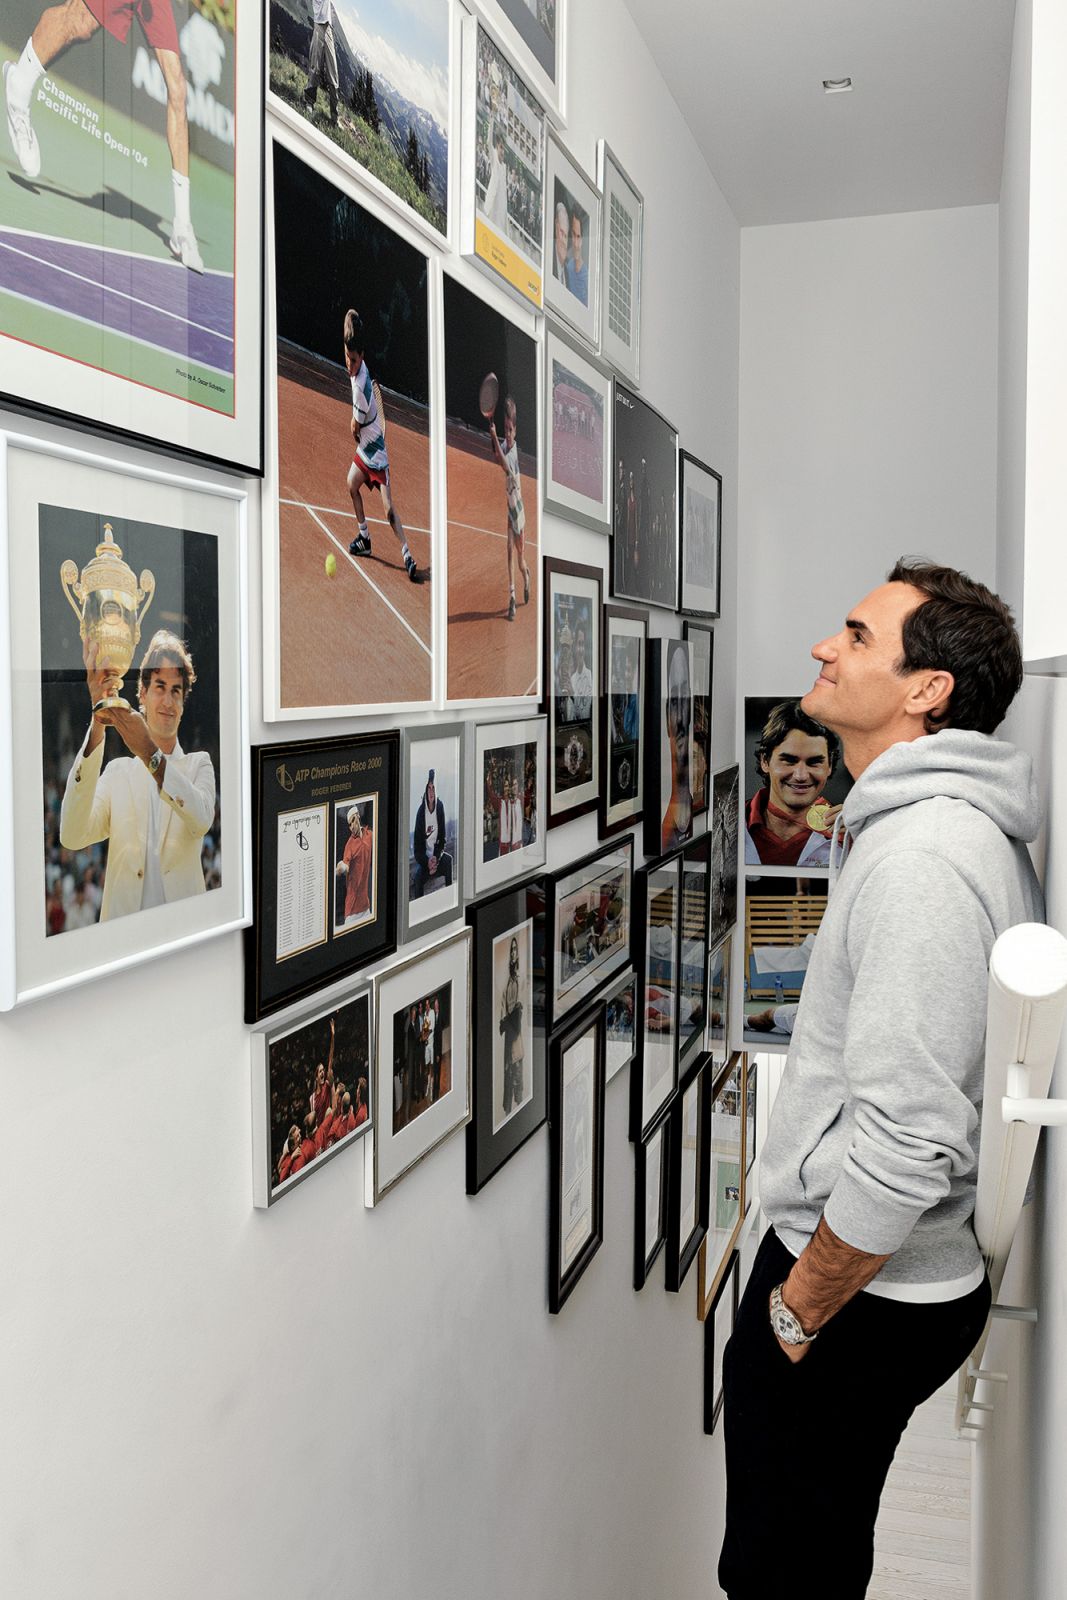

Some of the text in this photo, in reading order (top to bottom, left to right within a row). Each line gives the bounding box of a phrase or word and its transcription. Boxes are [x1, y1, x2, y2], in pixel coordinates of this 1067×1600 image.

[42, 77, 100, 122] Champion
[37, 89, 149, 168] Pacific Life Open '04
[294, 756, 383, 783] ATP Champions Race 2000
[311, 786, 330, 798] ROGER
